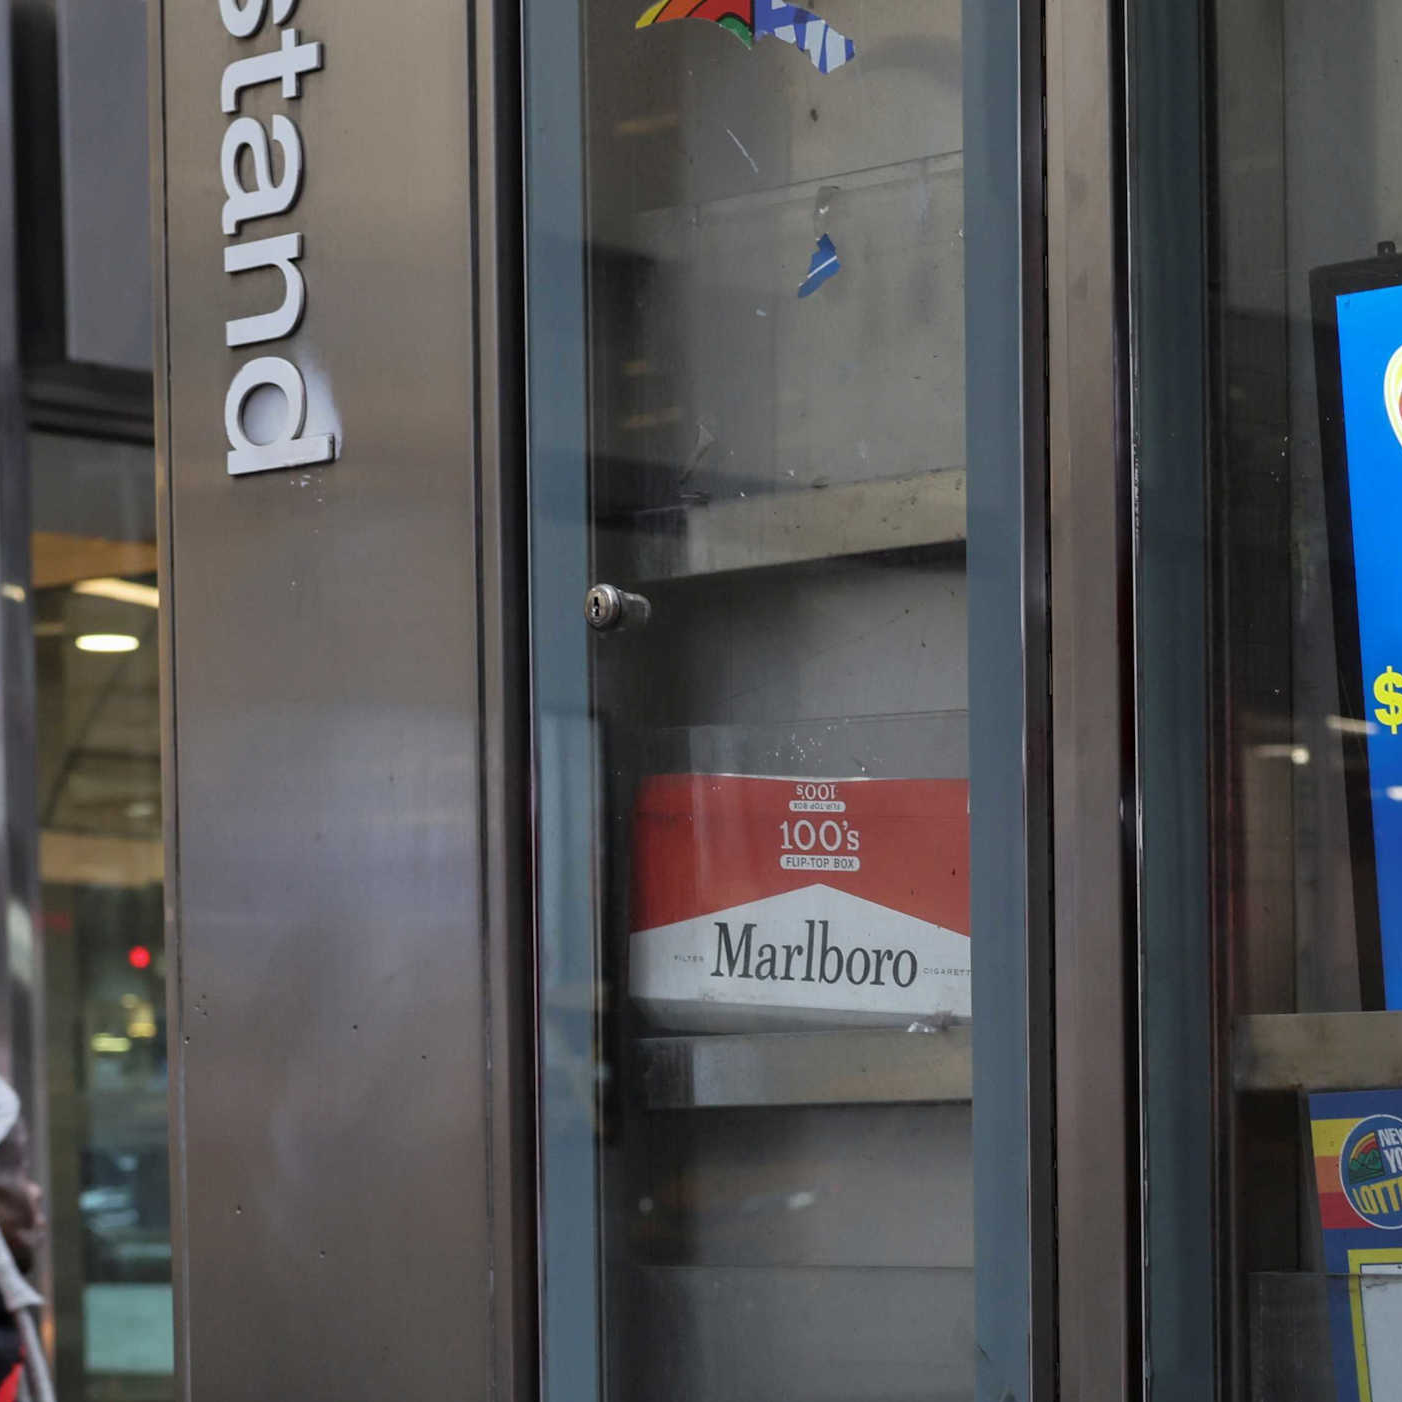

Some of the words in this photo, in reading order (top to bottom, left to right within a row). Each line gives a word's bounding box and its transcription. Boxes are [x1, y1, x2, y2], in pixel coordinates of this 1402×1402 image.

[780, 820, 860, 851] 100's
[786, 856, 830, 869] FLIP-TOP
[833, 858, 854, 869] BOX
[711, 920, 917, 987] Marlboro
